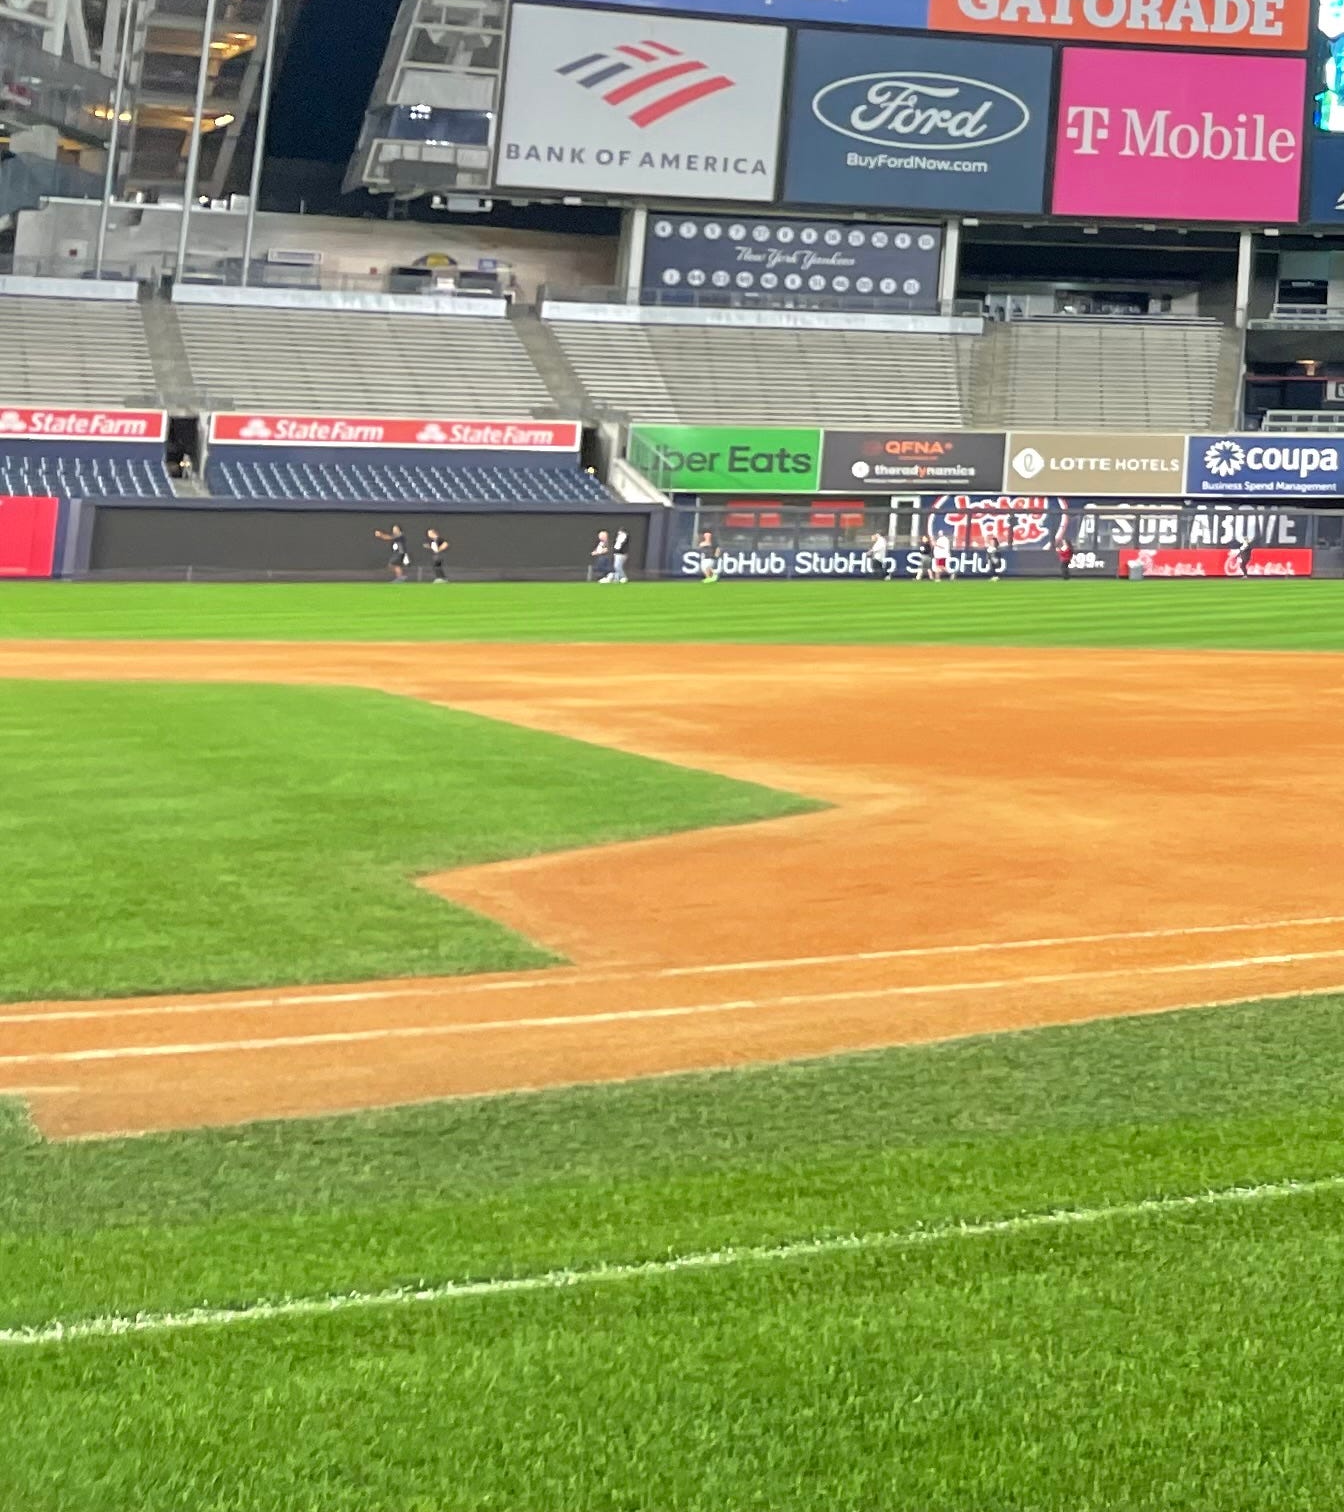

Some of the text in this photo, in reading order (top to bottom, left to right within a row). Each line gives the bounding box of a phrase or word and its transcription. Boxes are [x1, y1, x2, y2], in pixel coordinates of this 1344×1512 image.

[850, 80, 994, 139] Ford
[1066, 105, 1296, 164] T Mobile
[505, 142, 768, 176] BANK OF AMERICA
[846, 152, 988, 174] BuyFordNow.com
[29, 412, 147, 435] State Farm
[275, 419, 384, 442] State Farm
[444, 424, 554, 445] State Farm
[728, 445, 812, 474] Eats
[874, 464, 976, 478] theradynamics
[1050, 457, 1180, 473] LOTTE HOTELS
[1246, 446, 1338, 478] coupa
[682, 551, 786, 575] SubHub
[795, 551, 897, 575] StubHb
[906, 552, 1007, 574] SbHub
